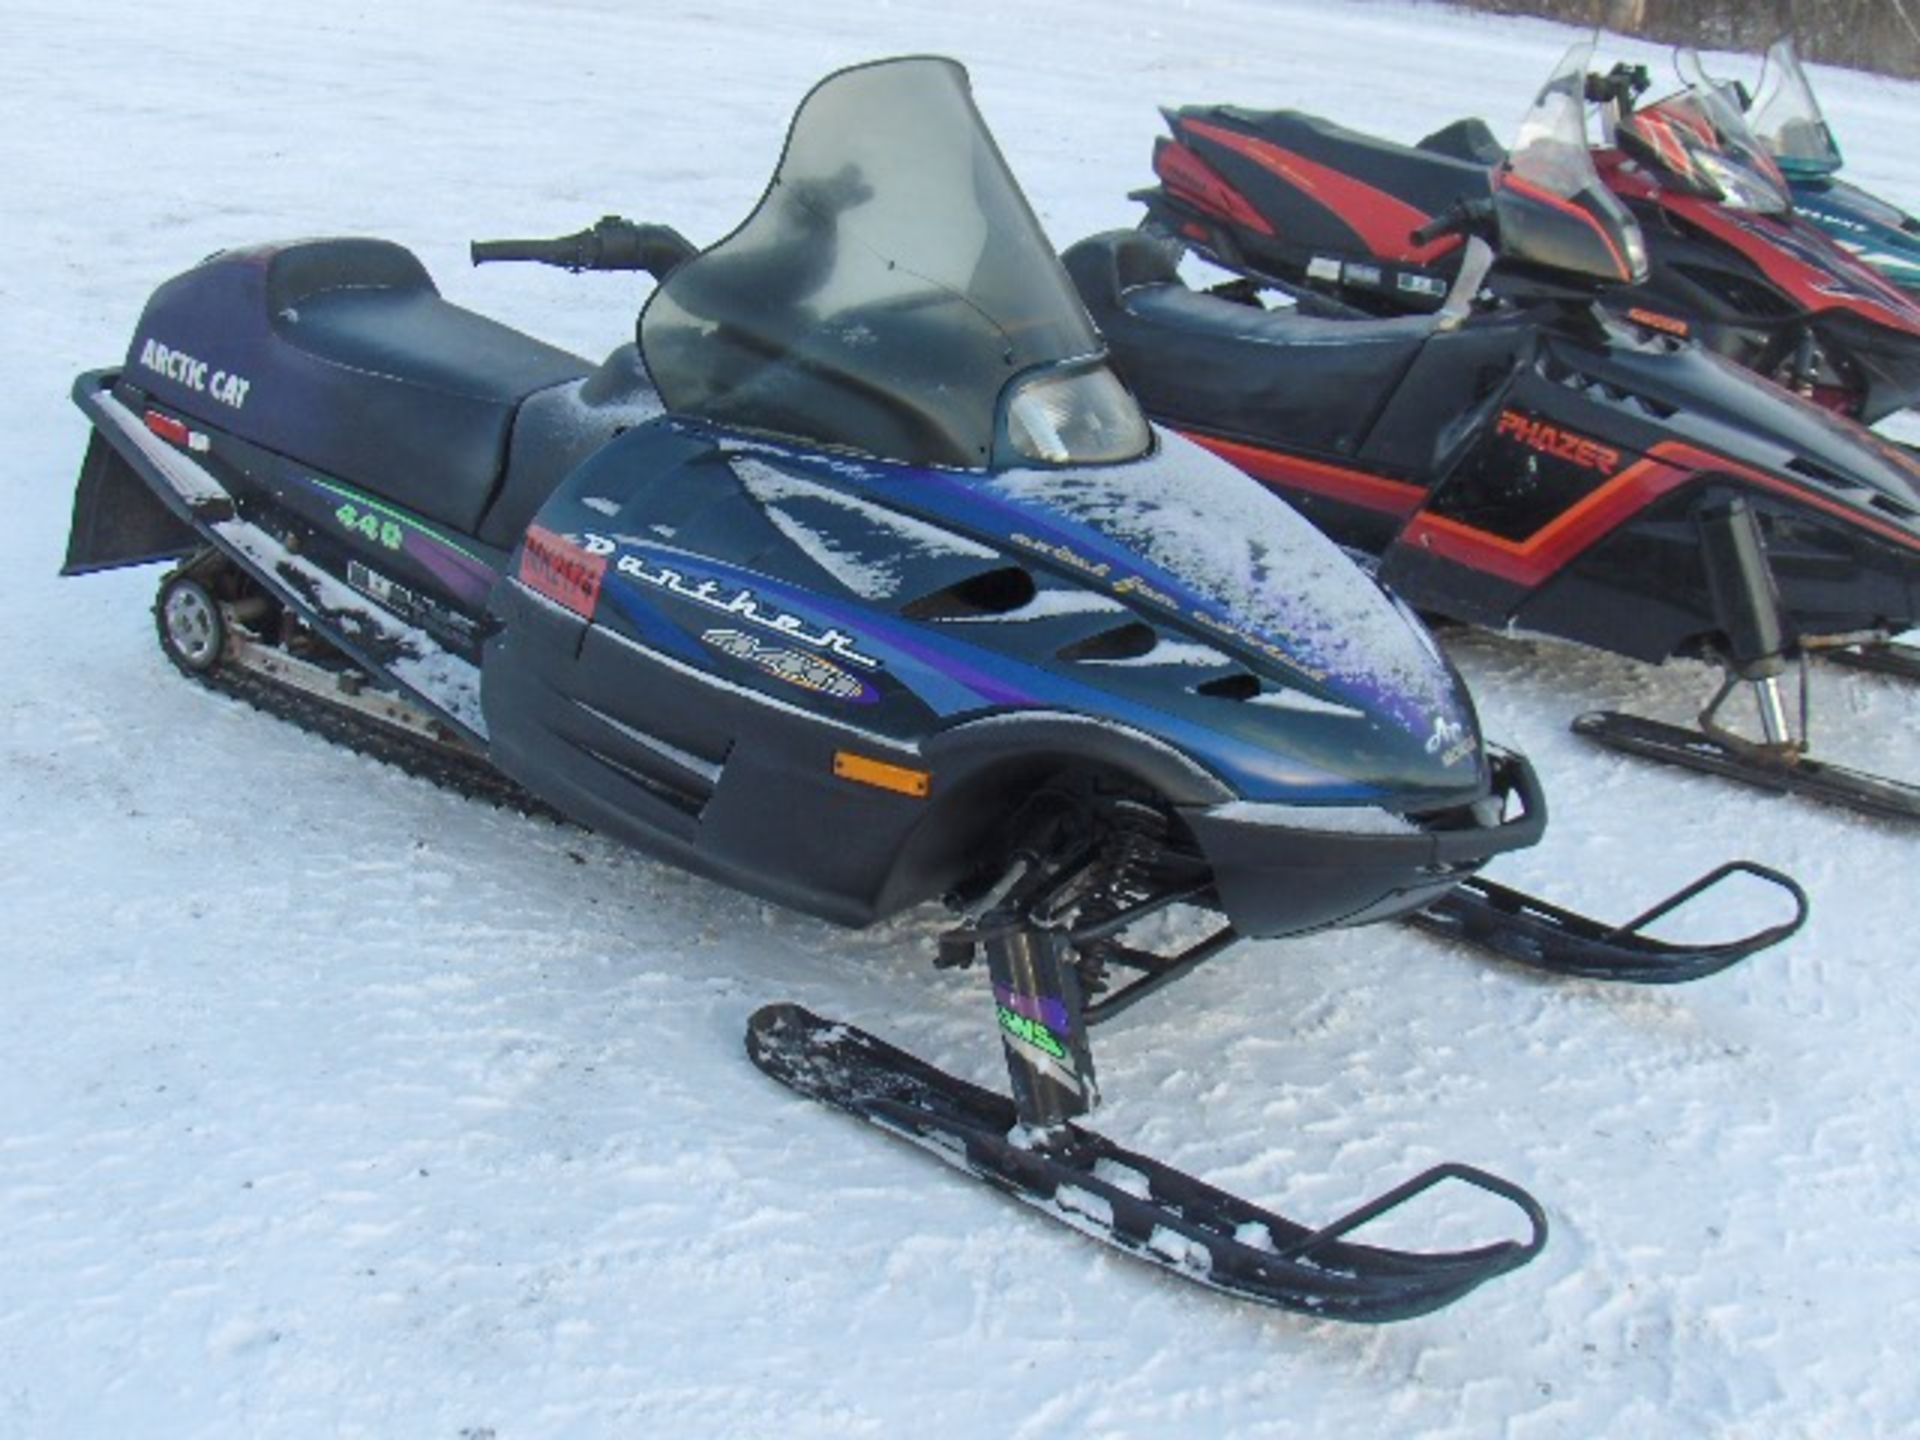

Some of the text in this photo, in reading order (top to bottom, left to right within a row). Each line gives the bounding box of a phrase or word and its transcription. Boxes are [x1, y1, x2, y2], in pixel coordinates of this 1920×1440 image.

[140, 338, 250, 409] ARCTIC CAT
[1497, 410, 1621, 475] PHAZER
[335, 504, 402, 550] 440
[583, 533, 877, 667] Panther
